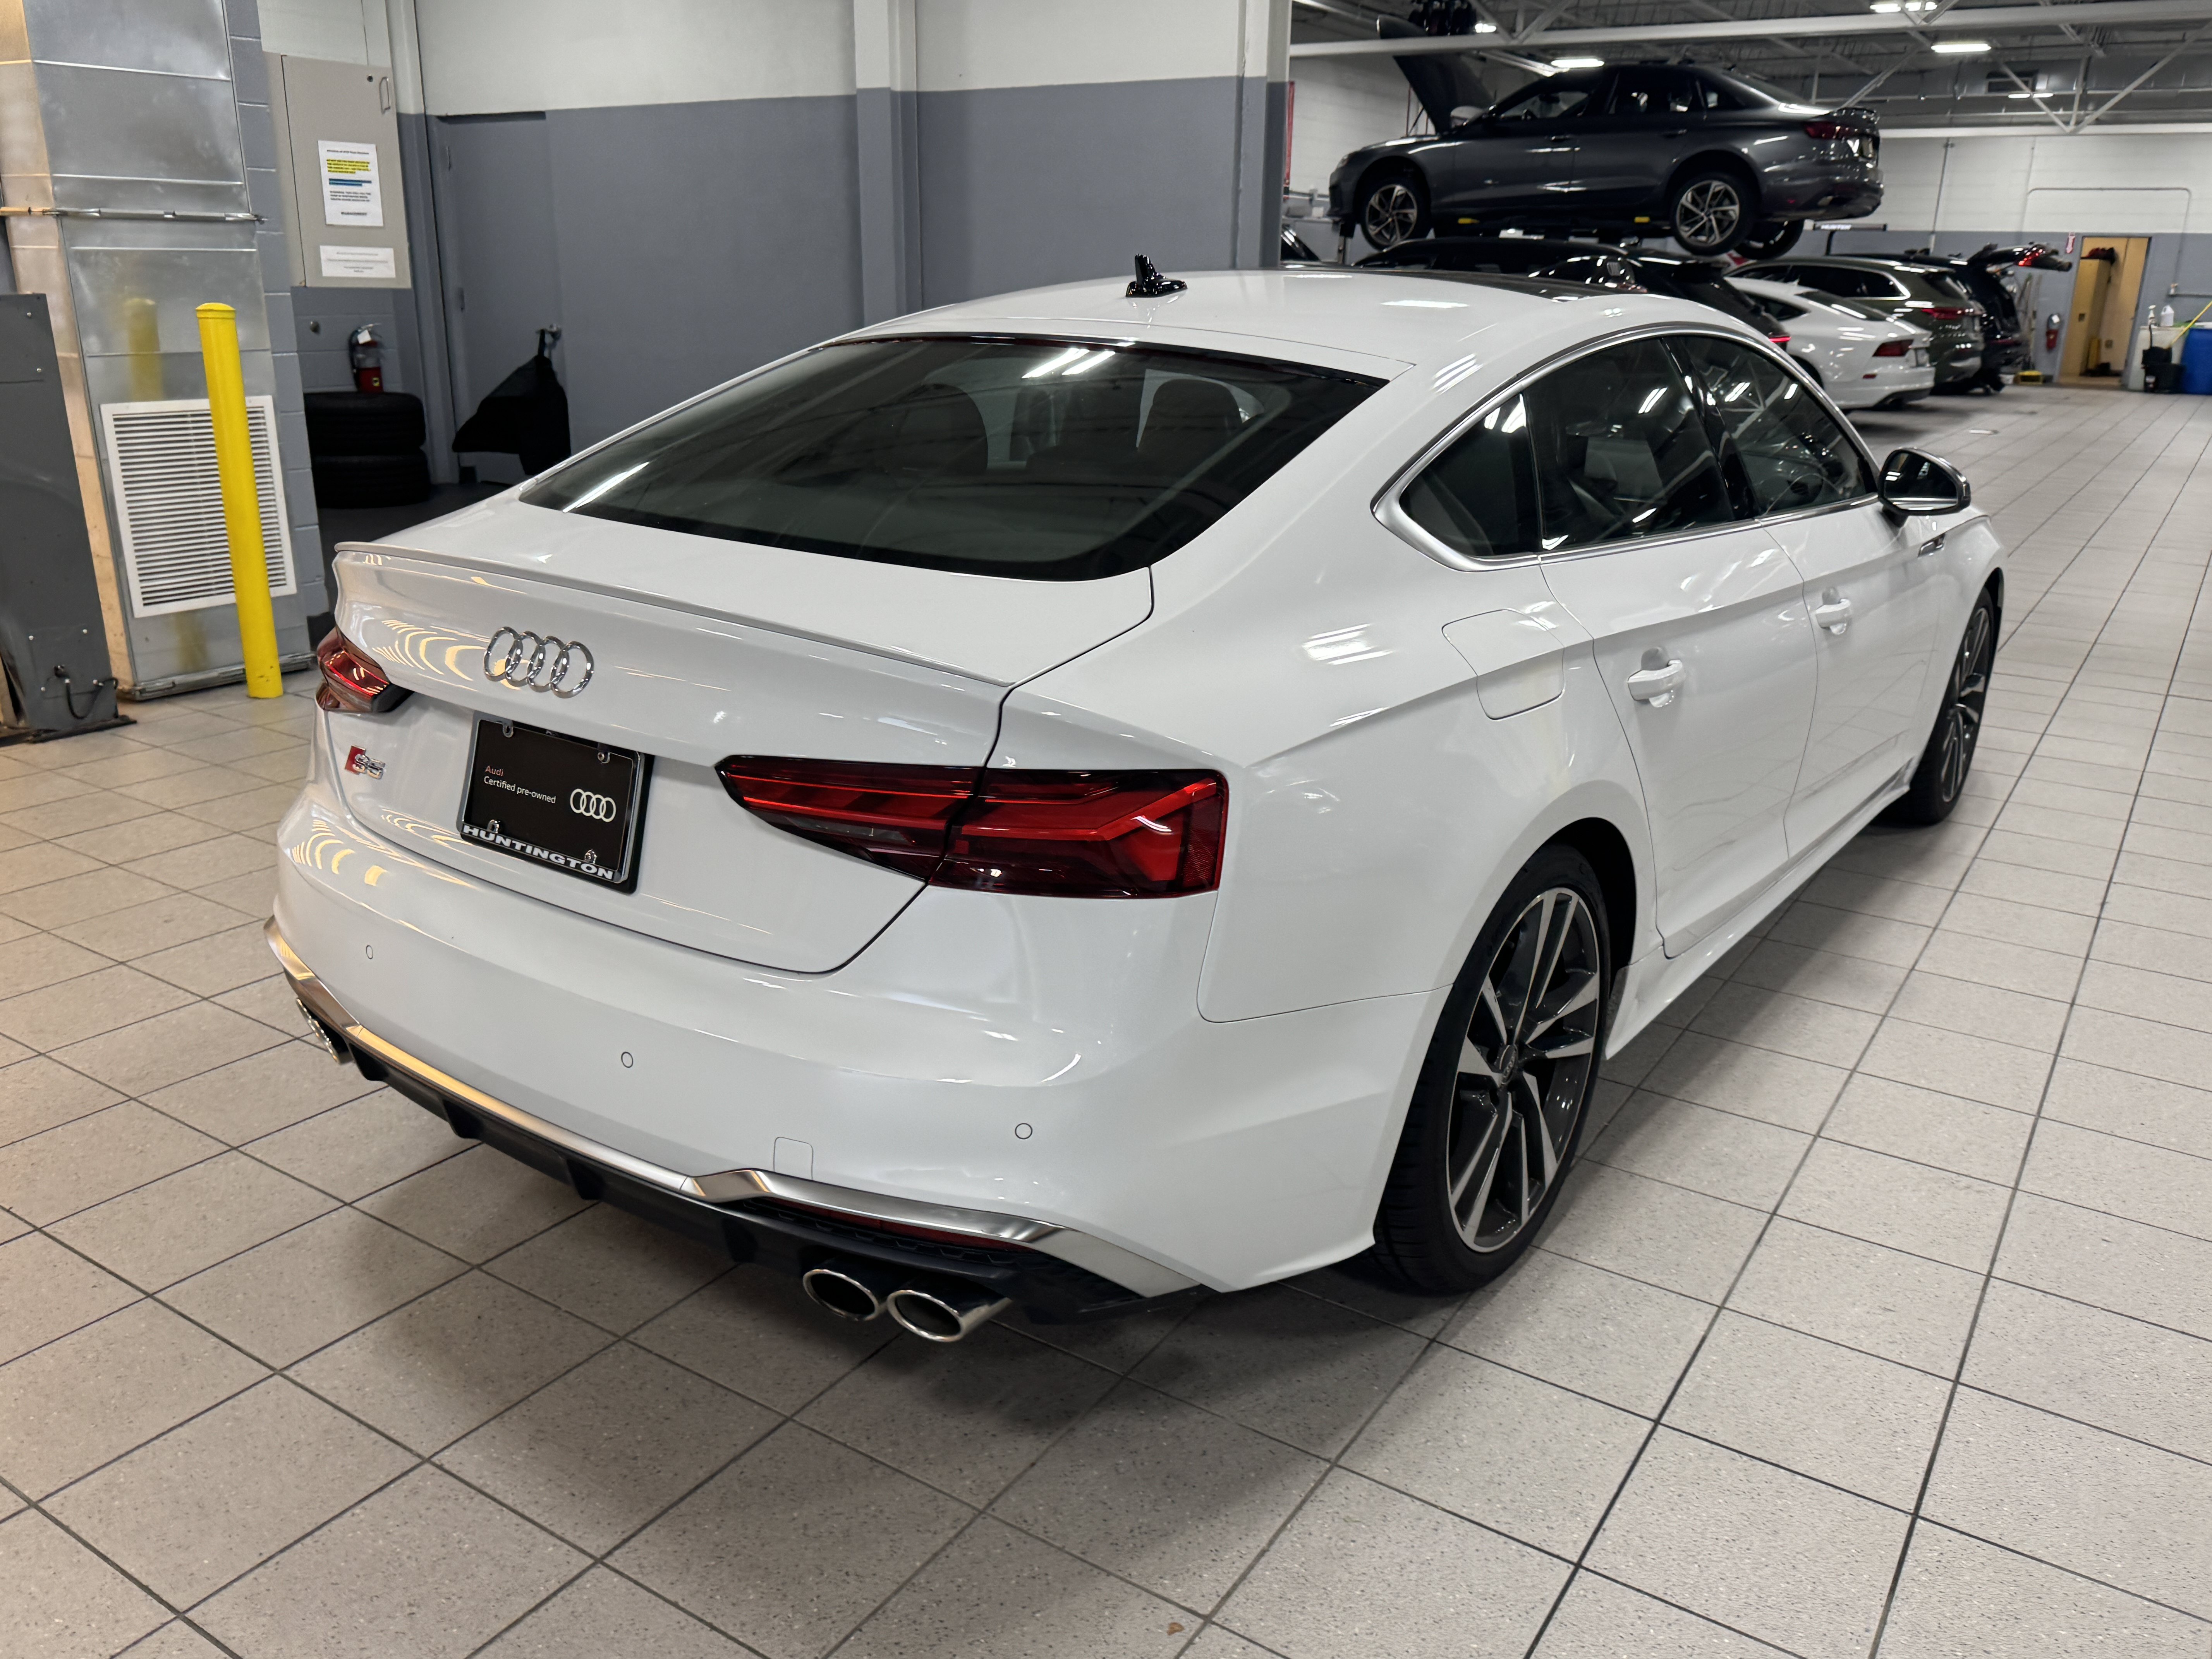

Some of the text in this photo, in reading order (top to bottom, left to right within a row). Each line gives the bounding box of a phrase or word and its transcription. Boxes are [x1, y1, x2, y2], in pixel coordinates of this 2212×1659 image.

[351, 752, 386, 780] S5
[485, 765, 503, 776] Audi
[484, 776, 556, 804] Certified pre-owned
[463, 825, 613, 880] HUNTINGTON
